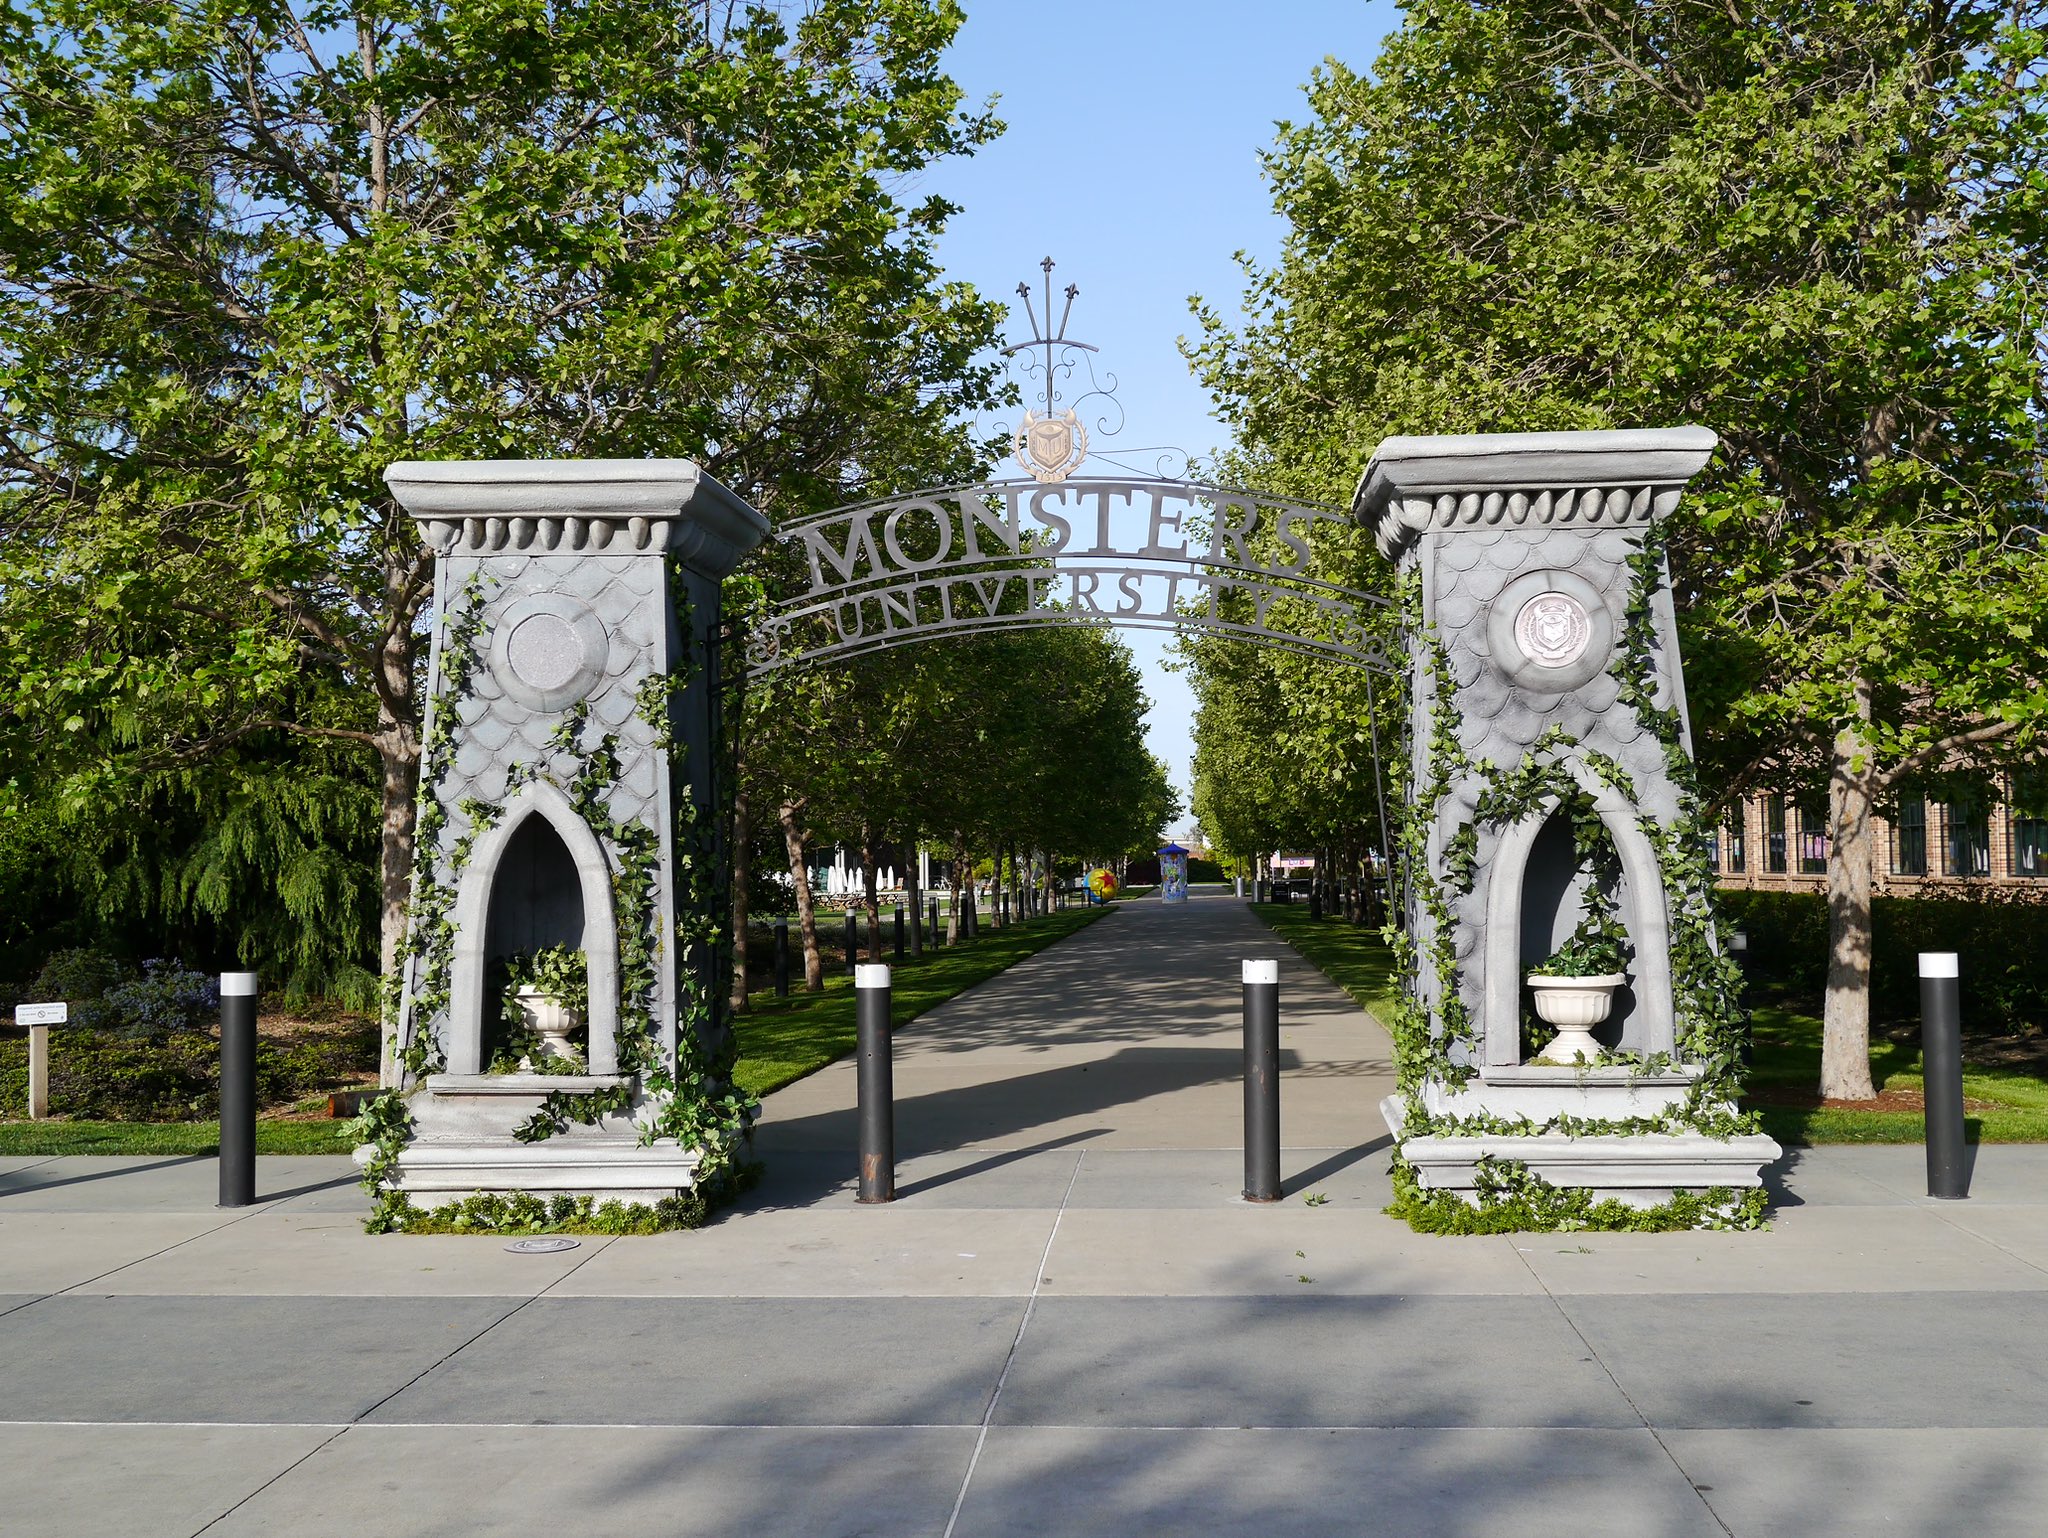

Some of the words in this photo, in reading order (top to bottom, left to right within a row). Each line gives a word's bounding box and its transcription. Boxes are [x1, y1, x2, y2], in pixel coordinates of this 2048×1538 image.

[1038, 438, 1062, 456] MU
[1041, 473, 1063, 481] 1313
[800, 484, 1313, 592] MONSTERS
[829, 570, 1289, 644] UNIVERSITY
